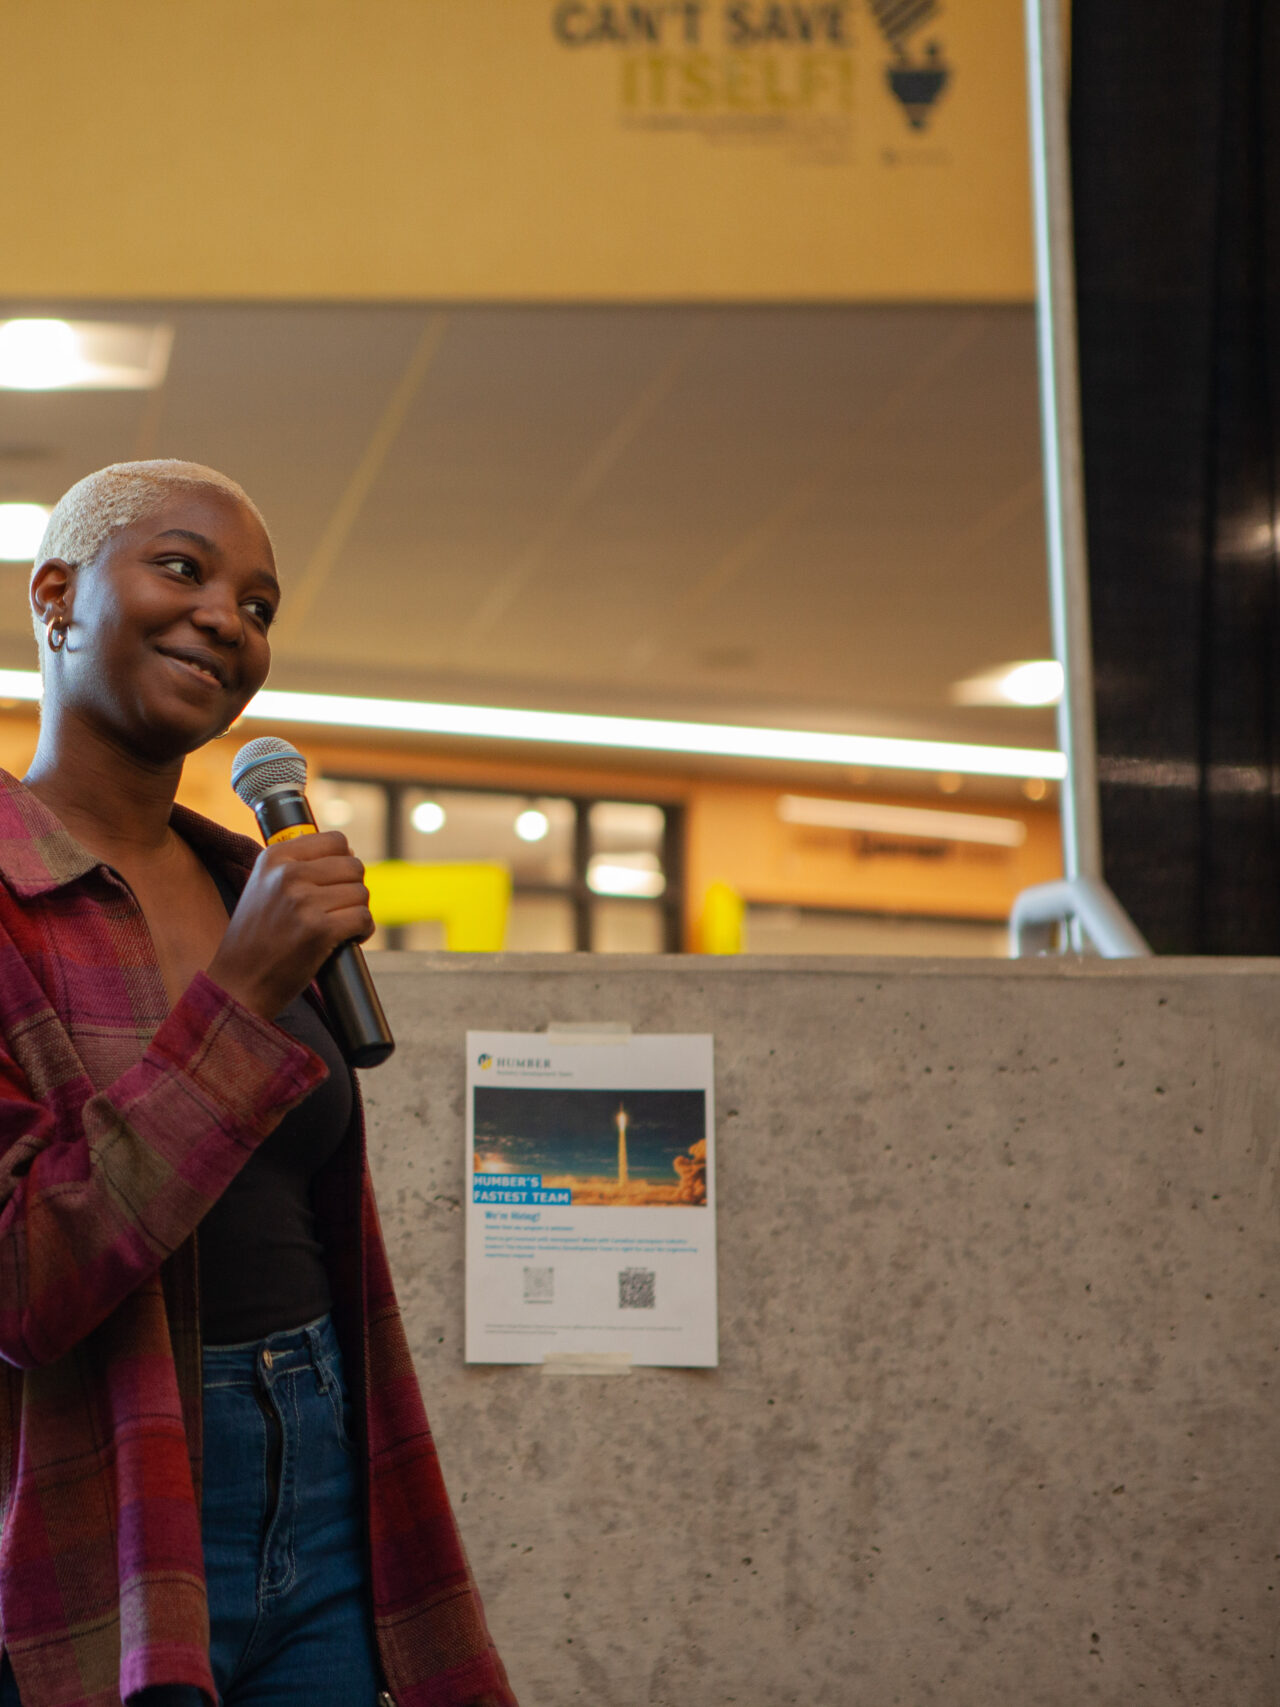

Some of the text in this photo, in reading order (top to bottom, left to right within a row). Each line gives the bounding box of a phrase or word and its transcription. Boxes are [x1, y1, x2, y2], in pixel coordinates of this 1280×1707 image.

[726, 0, 854, 46] SAVE
[497, 1058, 551, 1068] HUMBER
[474, 1176, 539, 1187] HUMBER'S
[474, 1191, 569, 1203] FASTEST TEAM
